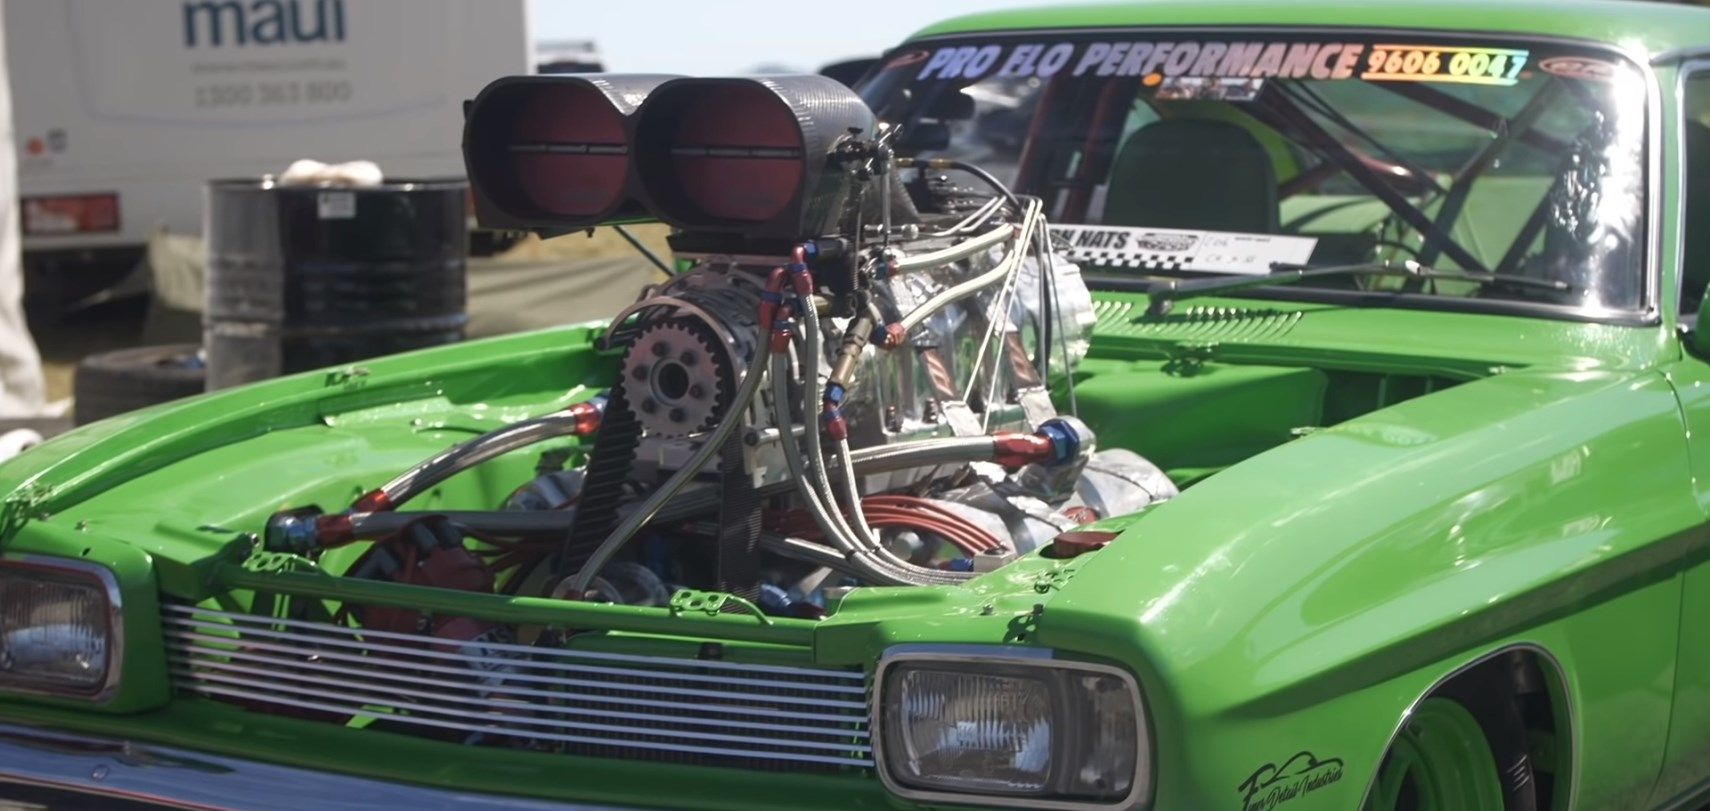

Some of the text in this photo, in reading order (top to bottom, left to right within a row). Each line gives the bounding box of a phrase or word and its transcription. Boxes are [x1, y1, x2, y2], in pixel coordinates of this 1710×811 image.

[182, 0, 347, 46] maui
[917, 45, 1001, 80] PRO
[998, 43, 1073, 78] FLO
[1073, 41, 1364, 80] PERFORMANCE
[1368, 50, 1441, 75] 9606
[1449, 52, 1528, 79] 0047
[1075, 230, 1131, 249] NATS
